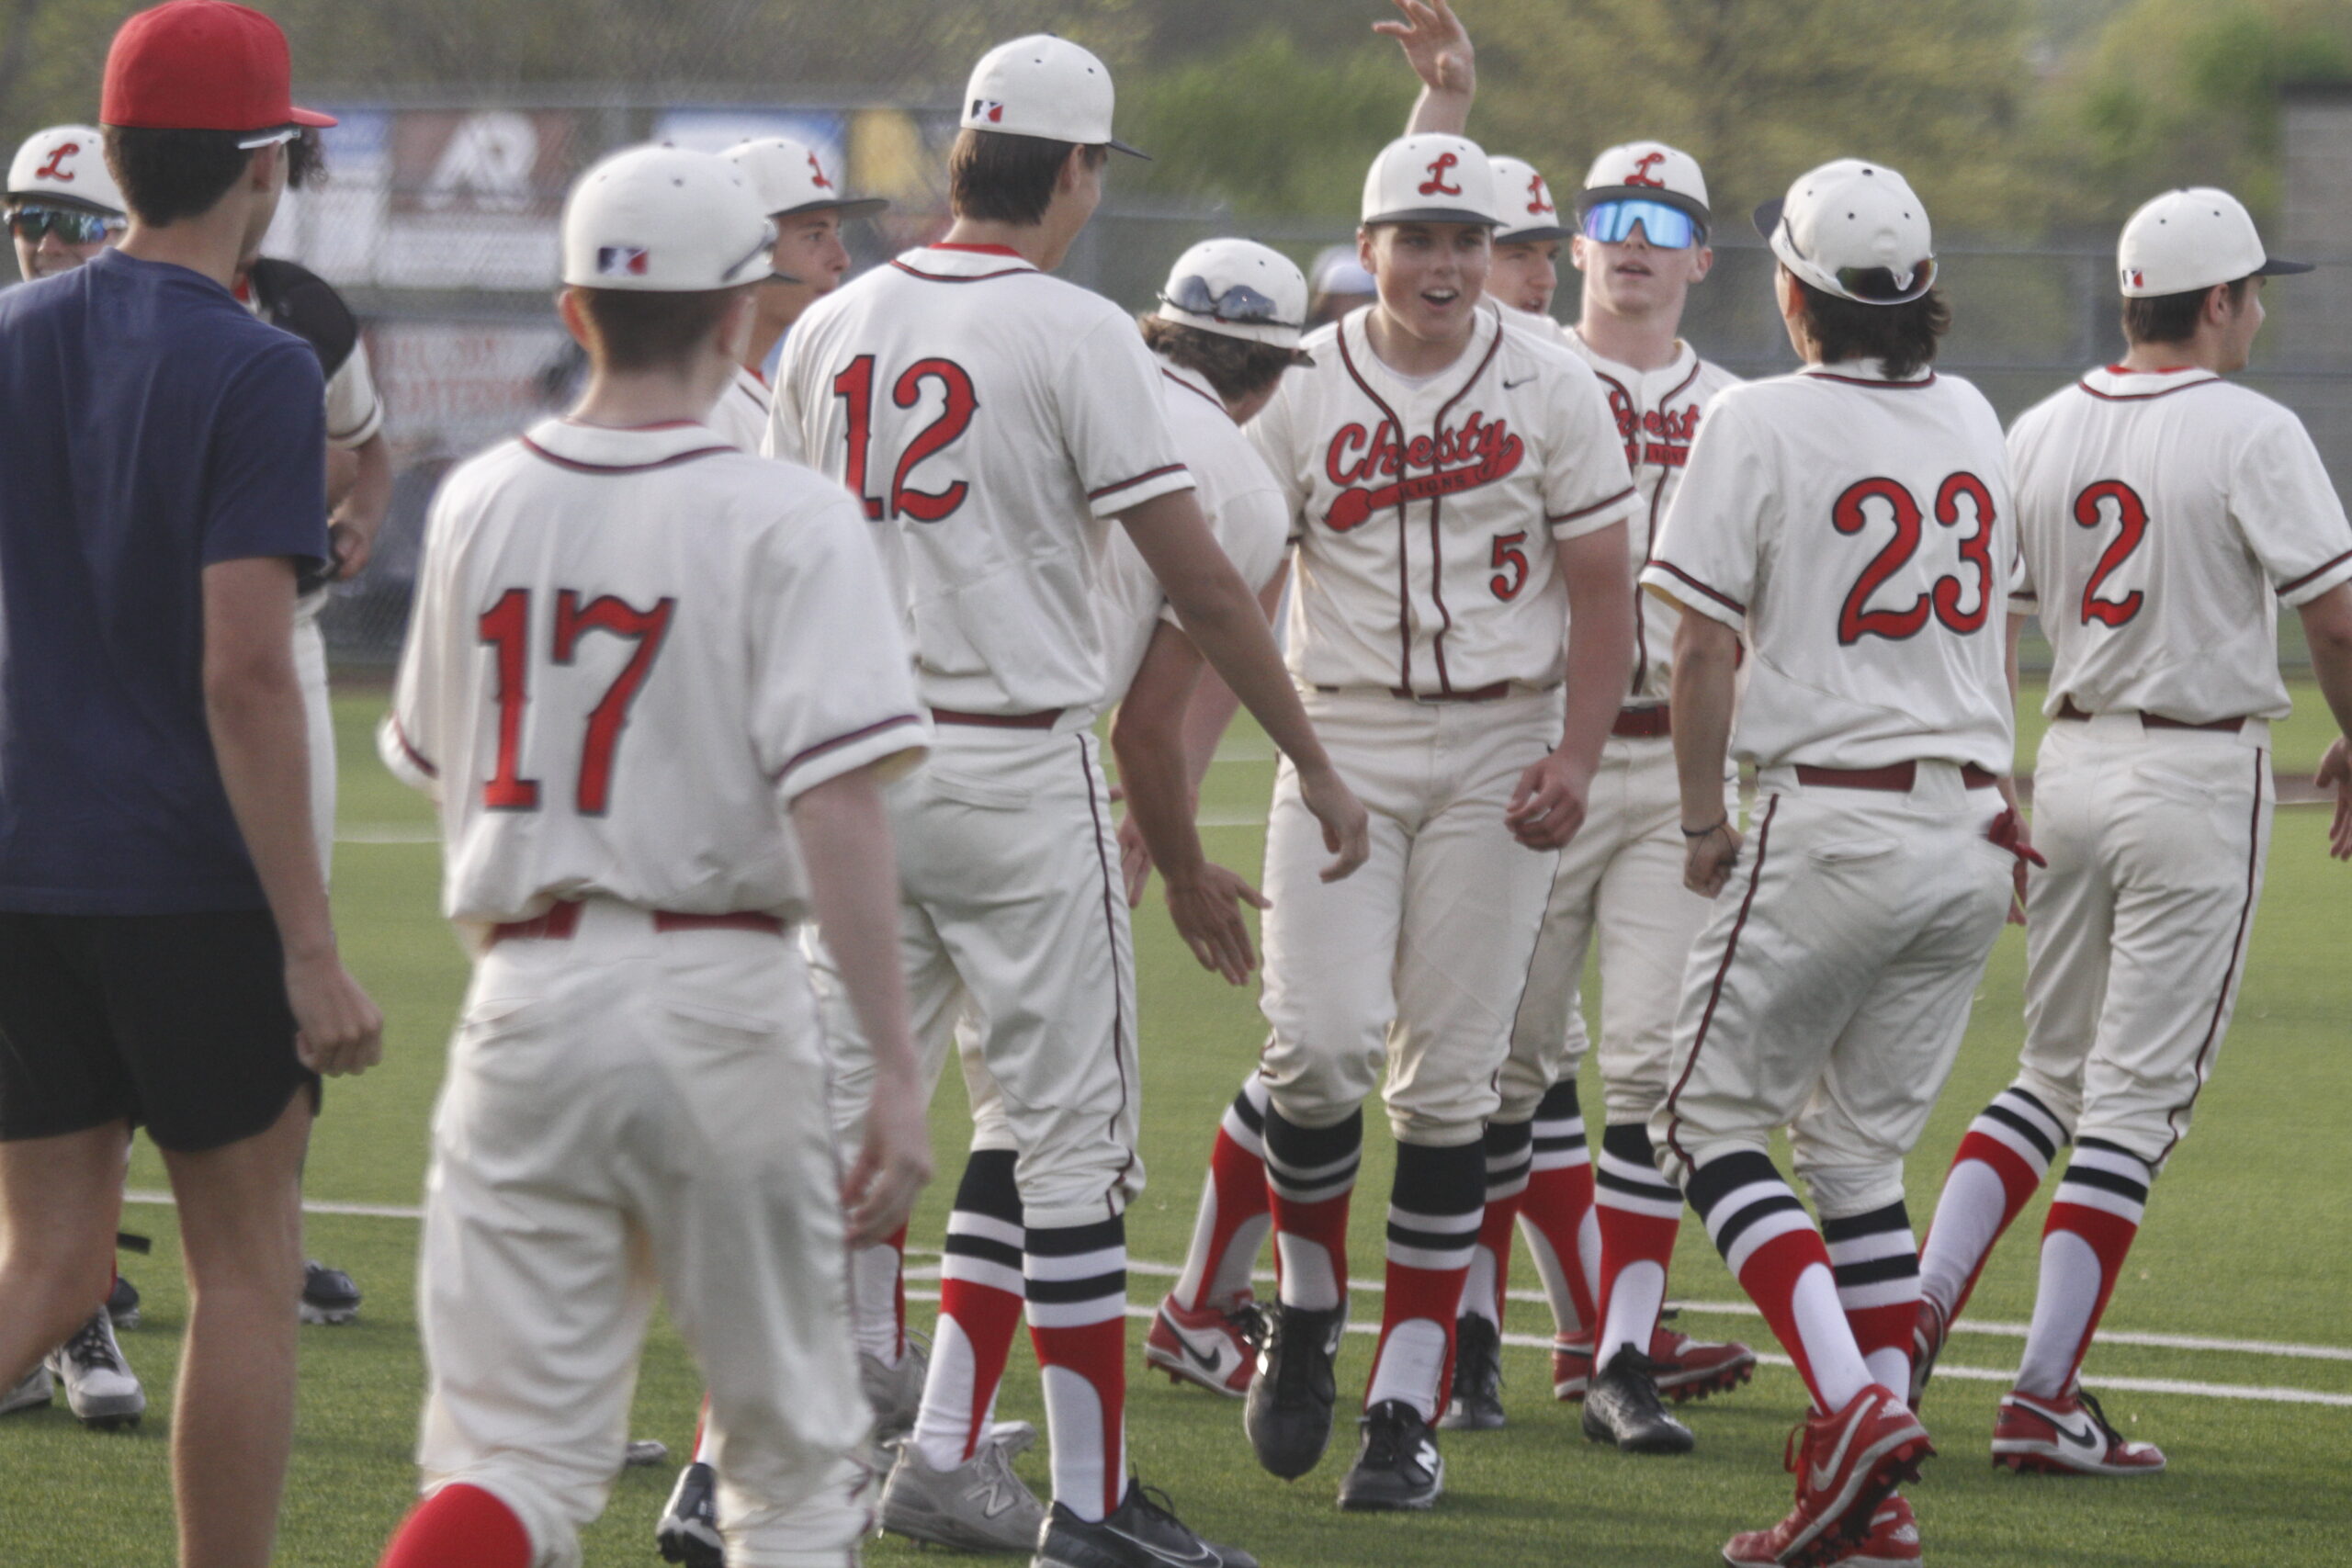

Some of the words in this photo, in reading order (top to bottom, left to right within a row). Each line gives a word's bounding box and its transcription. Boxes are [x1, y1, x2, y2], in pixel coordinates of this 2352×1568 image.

[35, 142, 80, 182] L
[1418, 152, 1463, 196] L
[1624, 152, 1665, 187] L
[834, 355, 979, 522] 12
[1326, 411, 1510, 486] Chesty
[1609, 390, 1701, 441] hest
[1489, 530, 1530, 603] 5
[1832, 471, 1996, 646] 23
[2074, 479, 2150, 627] 2
[478, 587, 677, 817] 17
